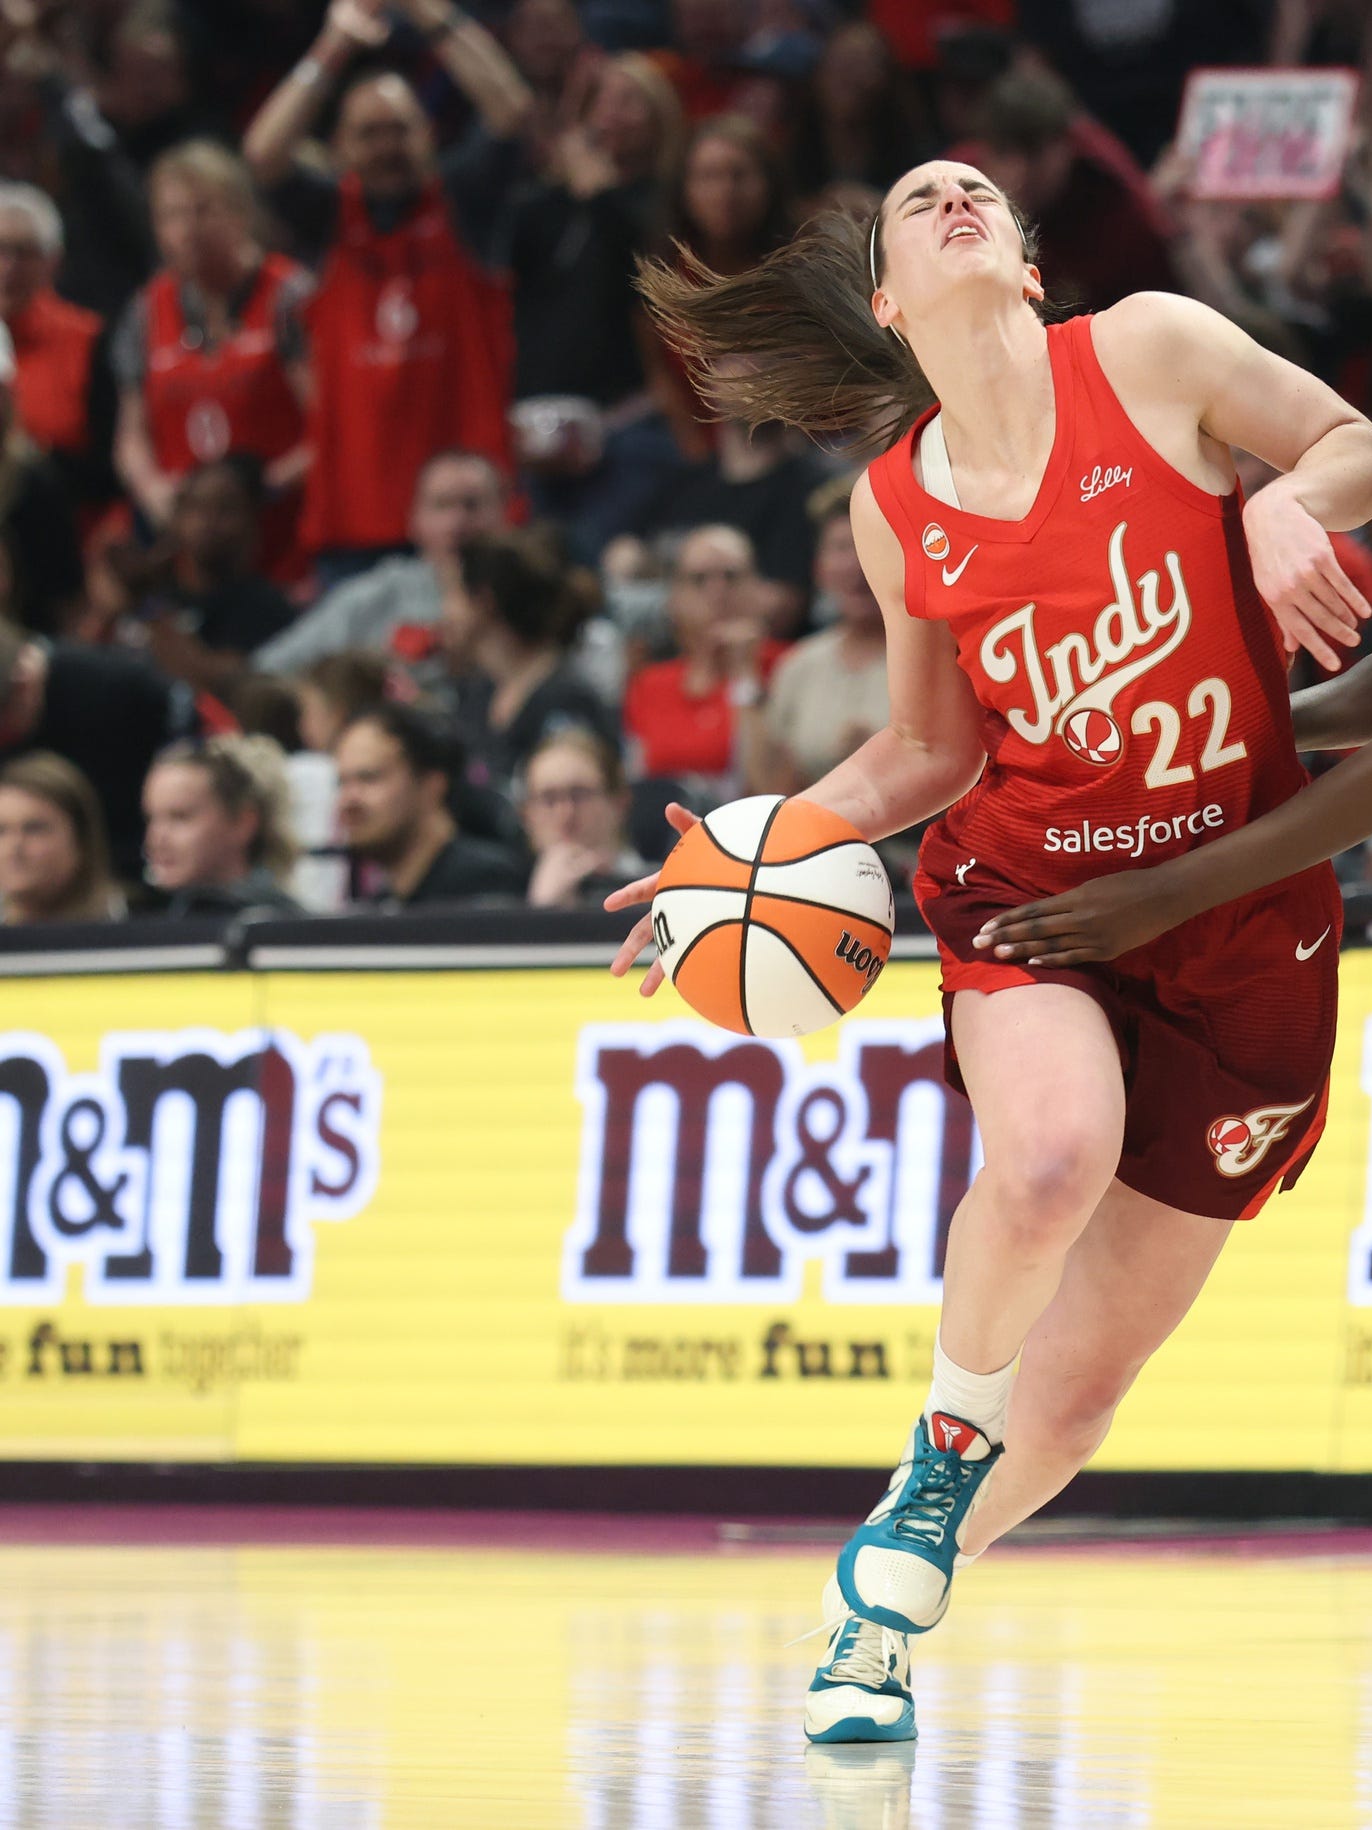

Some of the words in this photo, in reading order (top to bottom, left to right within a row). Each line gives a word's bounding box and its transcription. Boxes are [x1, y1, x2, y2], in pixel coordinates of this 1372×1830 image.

[1080, 465, 1133, 502] Lilly
[980, 521, 1192, 744] Indy
[1131, 677, 1247, 789] 22
[1044, 803, 1225, 858] salesforce
[28, 1322, 144, 1375] fun
[760, 1322, 889, 1378] fun
